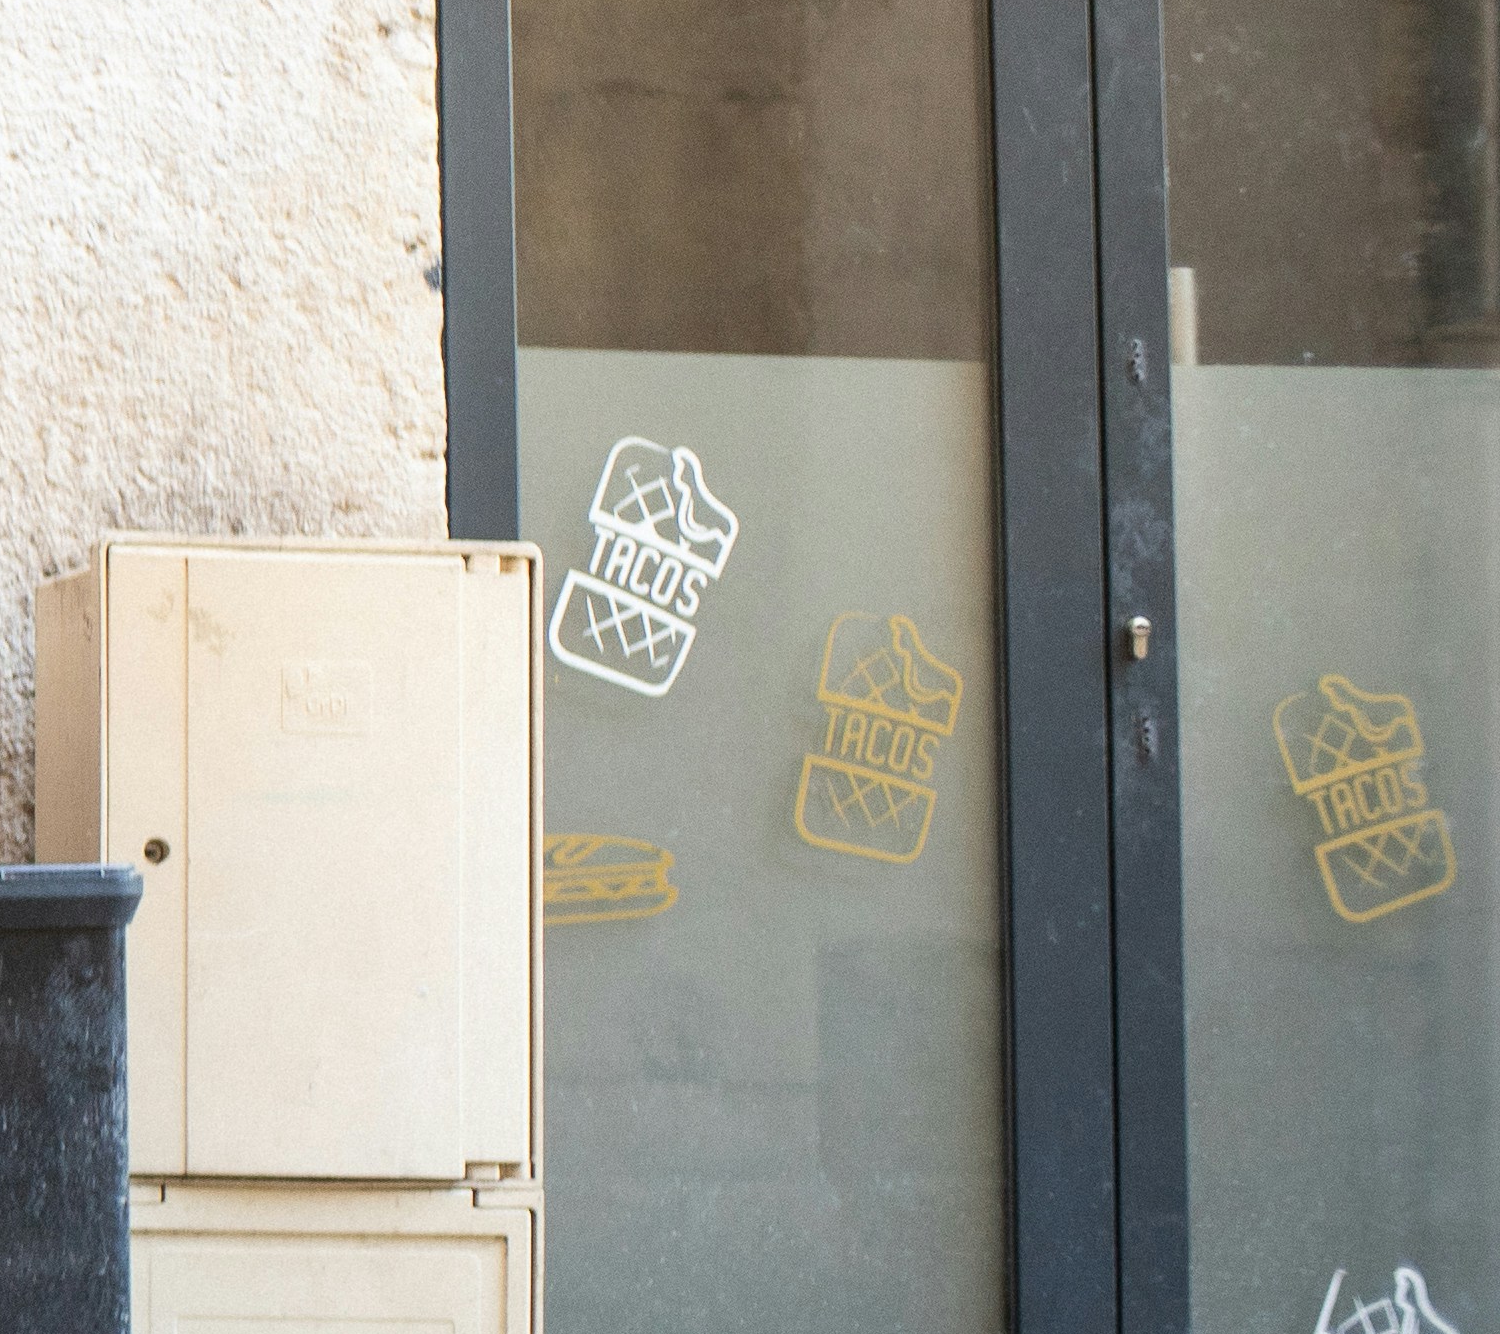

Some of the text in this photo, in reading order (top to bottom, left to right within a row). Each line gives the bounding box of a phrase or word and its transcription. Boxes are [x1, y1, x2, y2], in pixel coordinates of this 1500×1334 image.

[589, 524, 708, 617] TACOS
[824, 707, 940, 779] TACOS
[1307, 761, 1429, 835] TACOS
